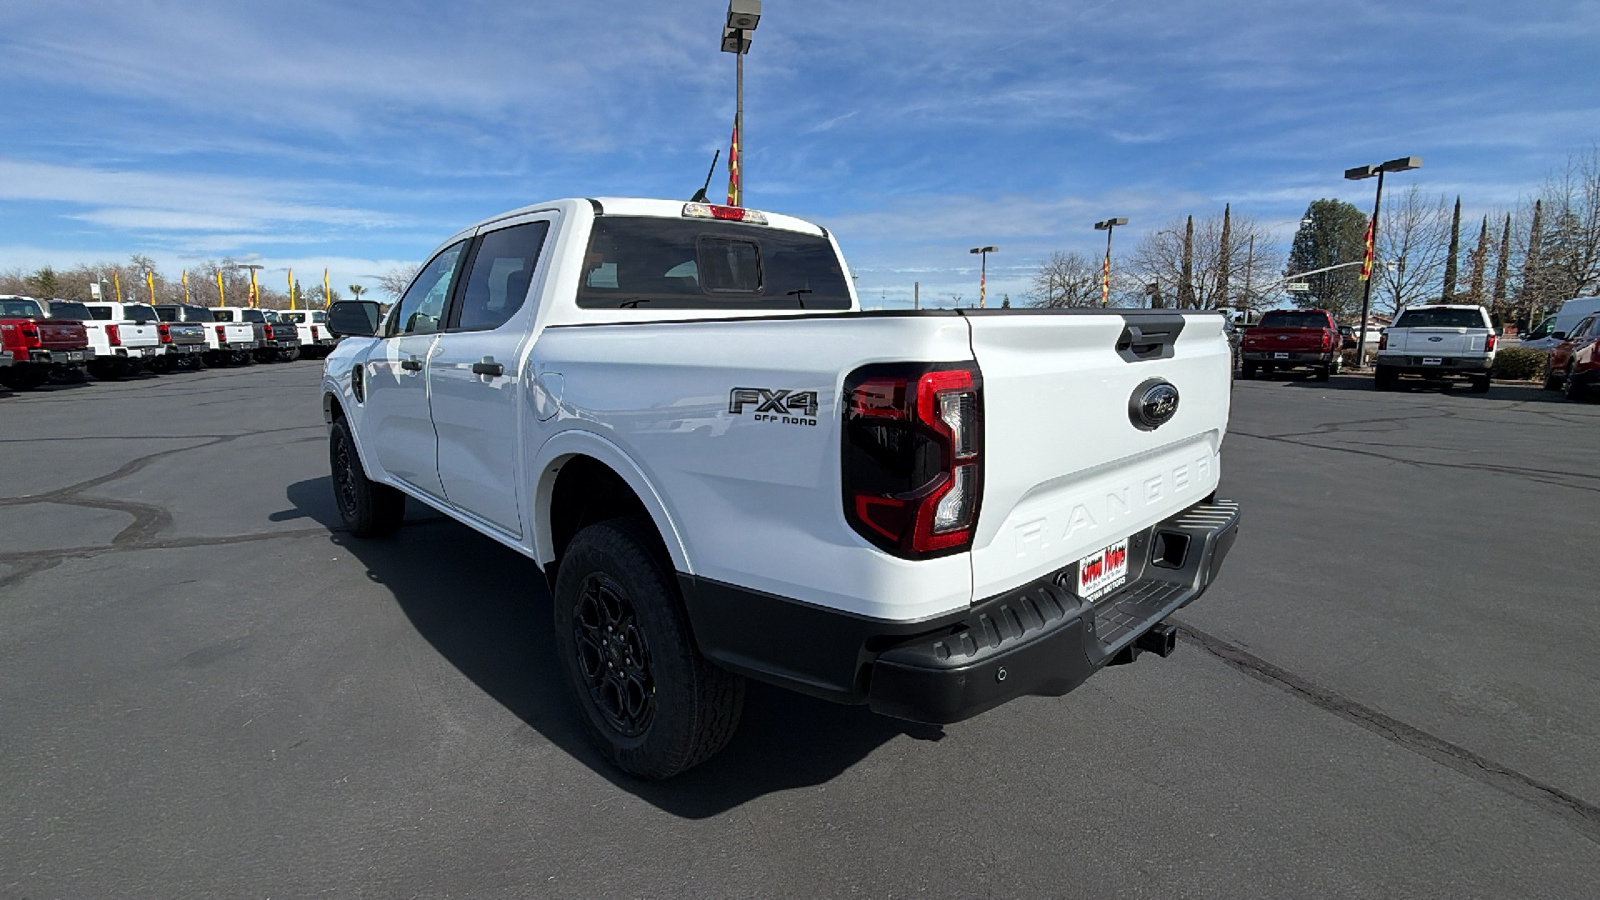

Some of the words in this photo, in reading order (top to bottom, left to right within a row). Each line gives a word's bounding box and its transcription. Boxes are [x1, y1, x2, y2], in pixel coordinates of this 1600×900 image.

[728, 387, 818, 417] FX4
[754, 414, 778, 423] OFF
[782, 416, 817, 426] ROAD
[1014, 455, 1211, 559] RANGER
[1104, 577, 1125, 593] MOTORS
